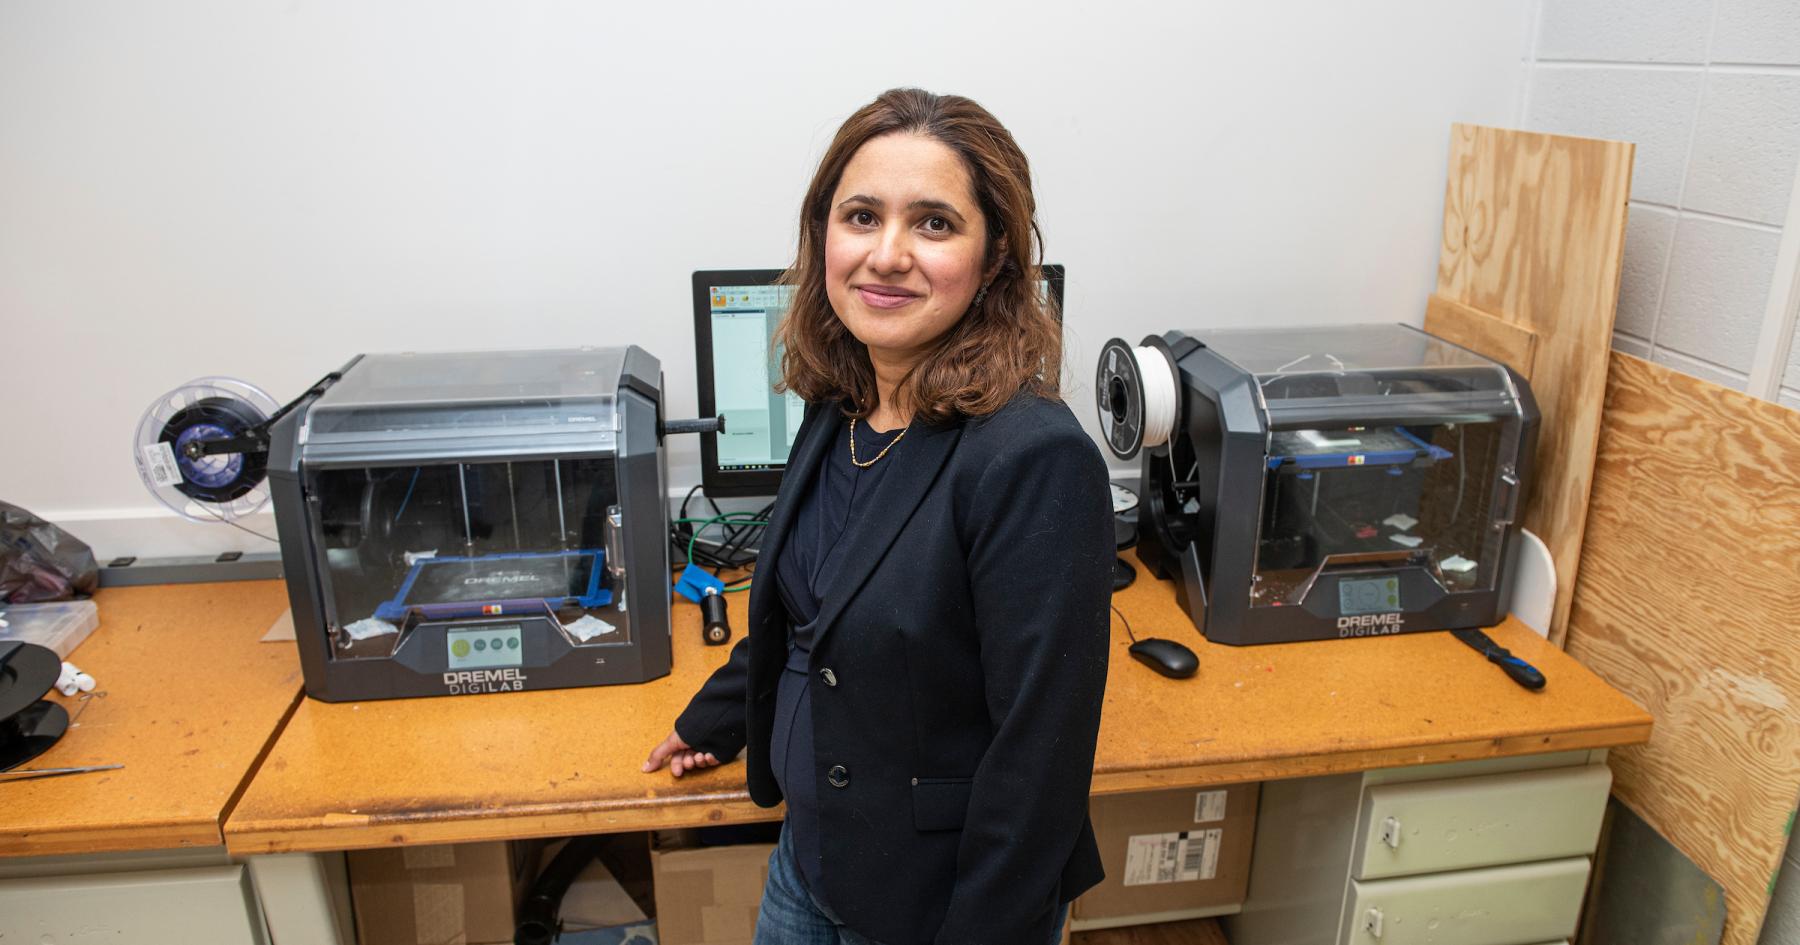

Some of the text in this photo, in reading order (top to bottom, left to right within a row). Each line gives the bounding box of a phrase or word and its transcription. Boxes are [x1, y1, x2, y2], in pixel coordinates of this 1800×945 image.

[464, 574, 540, 585] DREMEL
[1337, 613, 1405, 628] DREMEL
[1339, 624, 1401, 637] DIGILAB
[443, 668, 527, 685] DREMEL
[449, 680, 524, 695] DIGILAB
